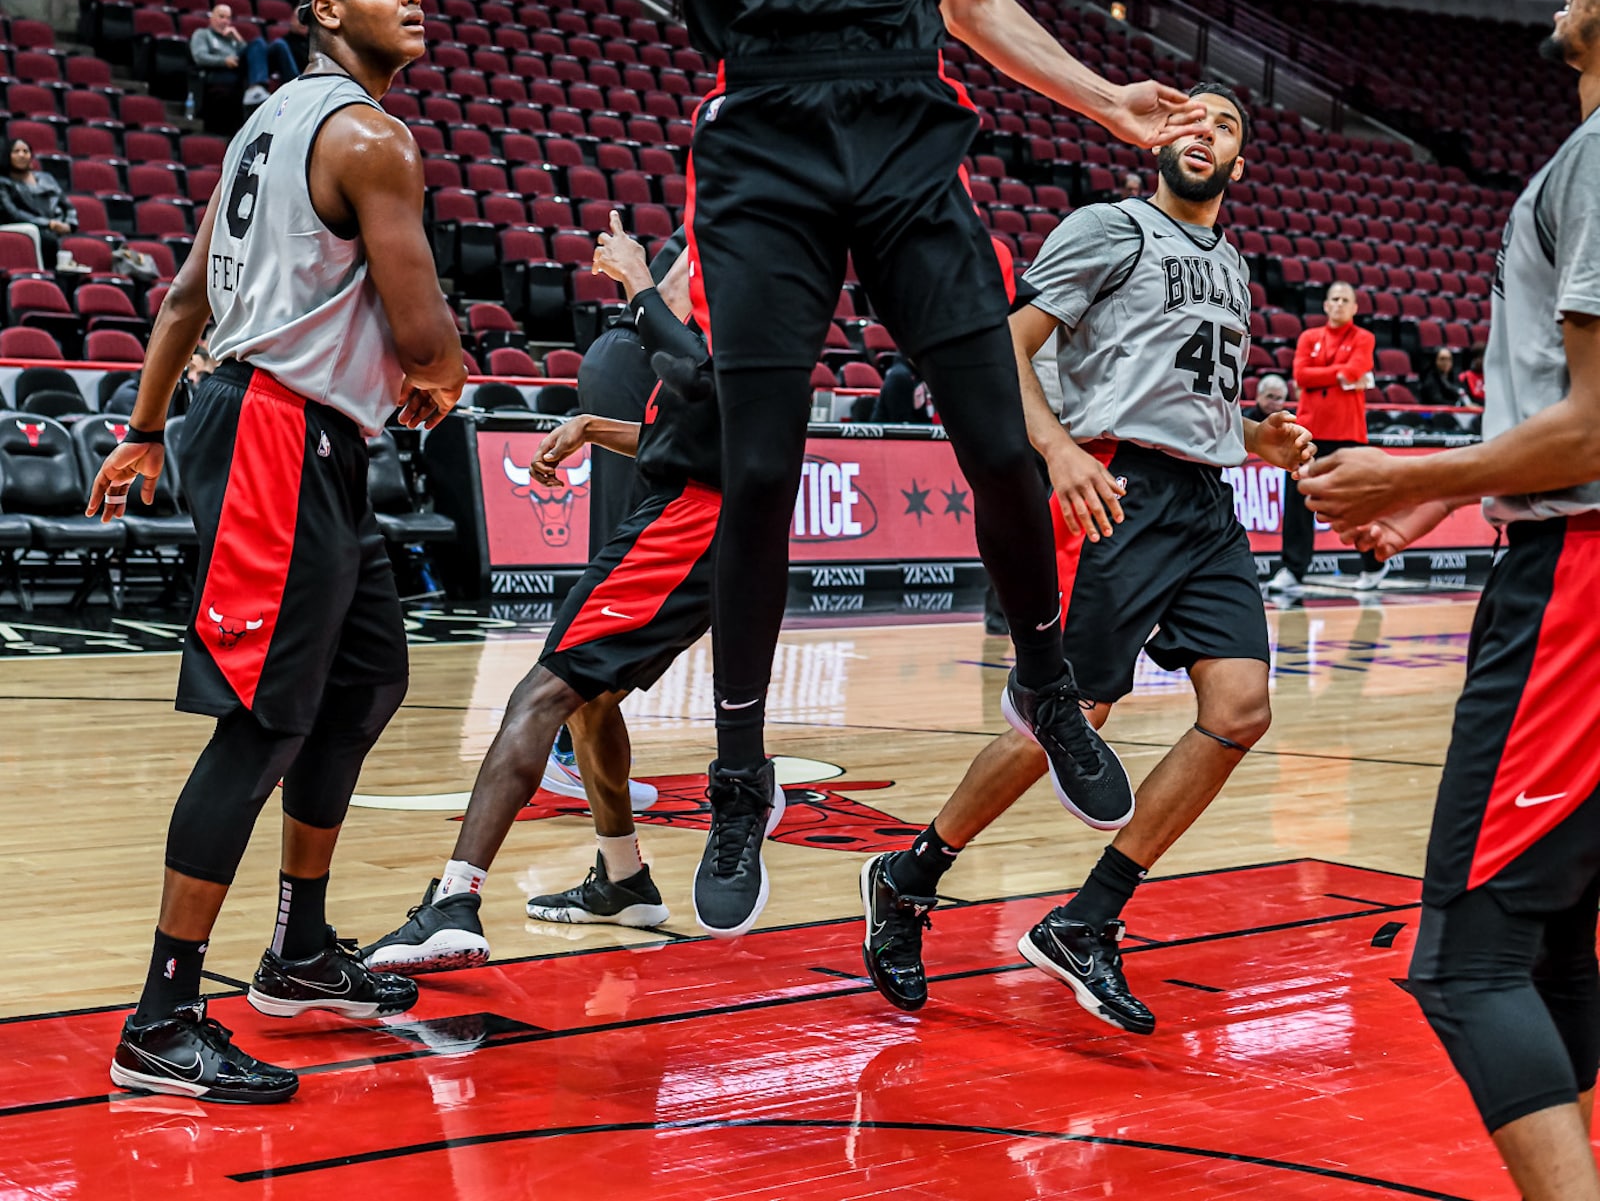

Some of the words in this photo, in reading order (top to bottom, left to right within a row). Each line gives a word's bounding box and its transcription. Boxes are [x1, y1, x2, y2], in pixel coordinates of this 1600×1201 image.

[226, 131, 274, 240] 6
[1174, 320, 1243, 403] 45
[794, 462, 862, 537] TICE
[1221, 466, 1286, 532] RACT
[491, 573, 554, 594] ZENNI
[811, 568, 866, 587] ZENNI
[903, 566, 955, 585] ZENNI
